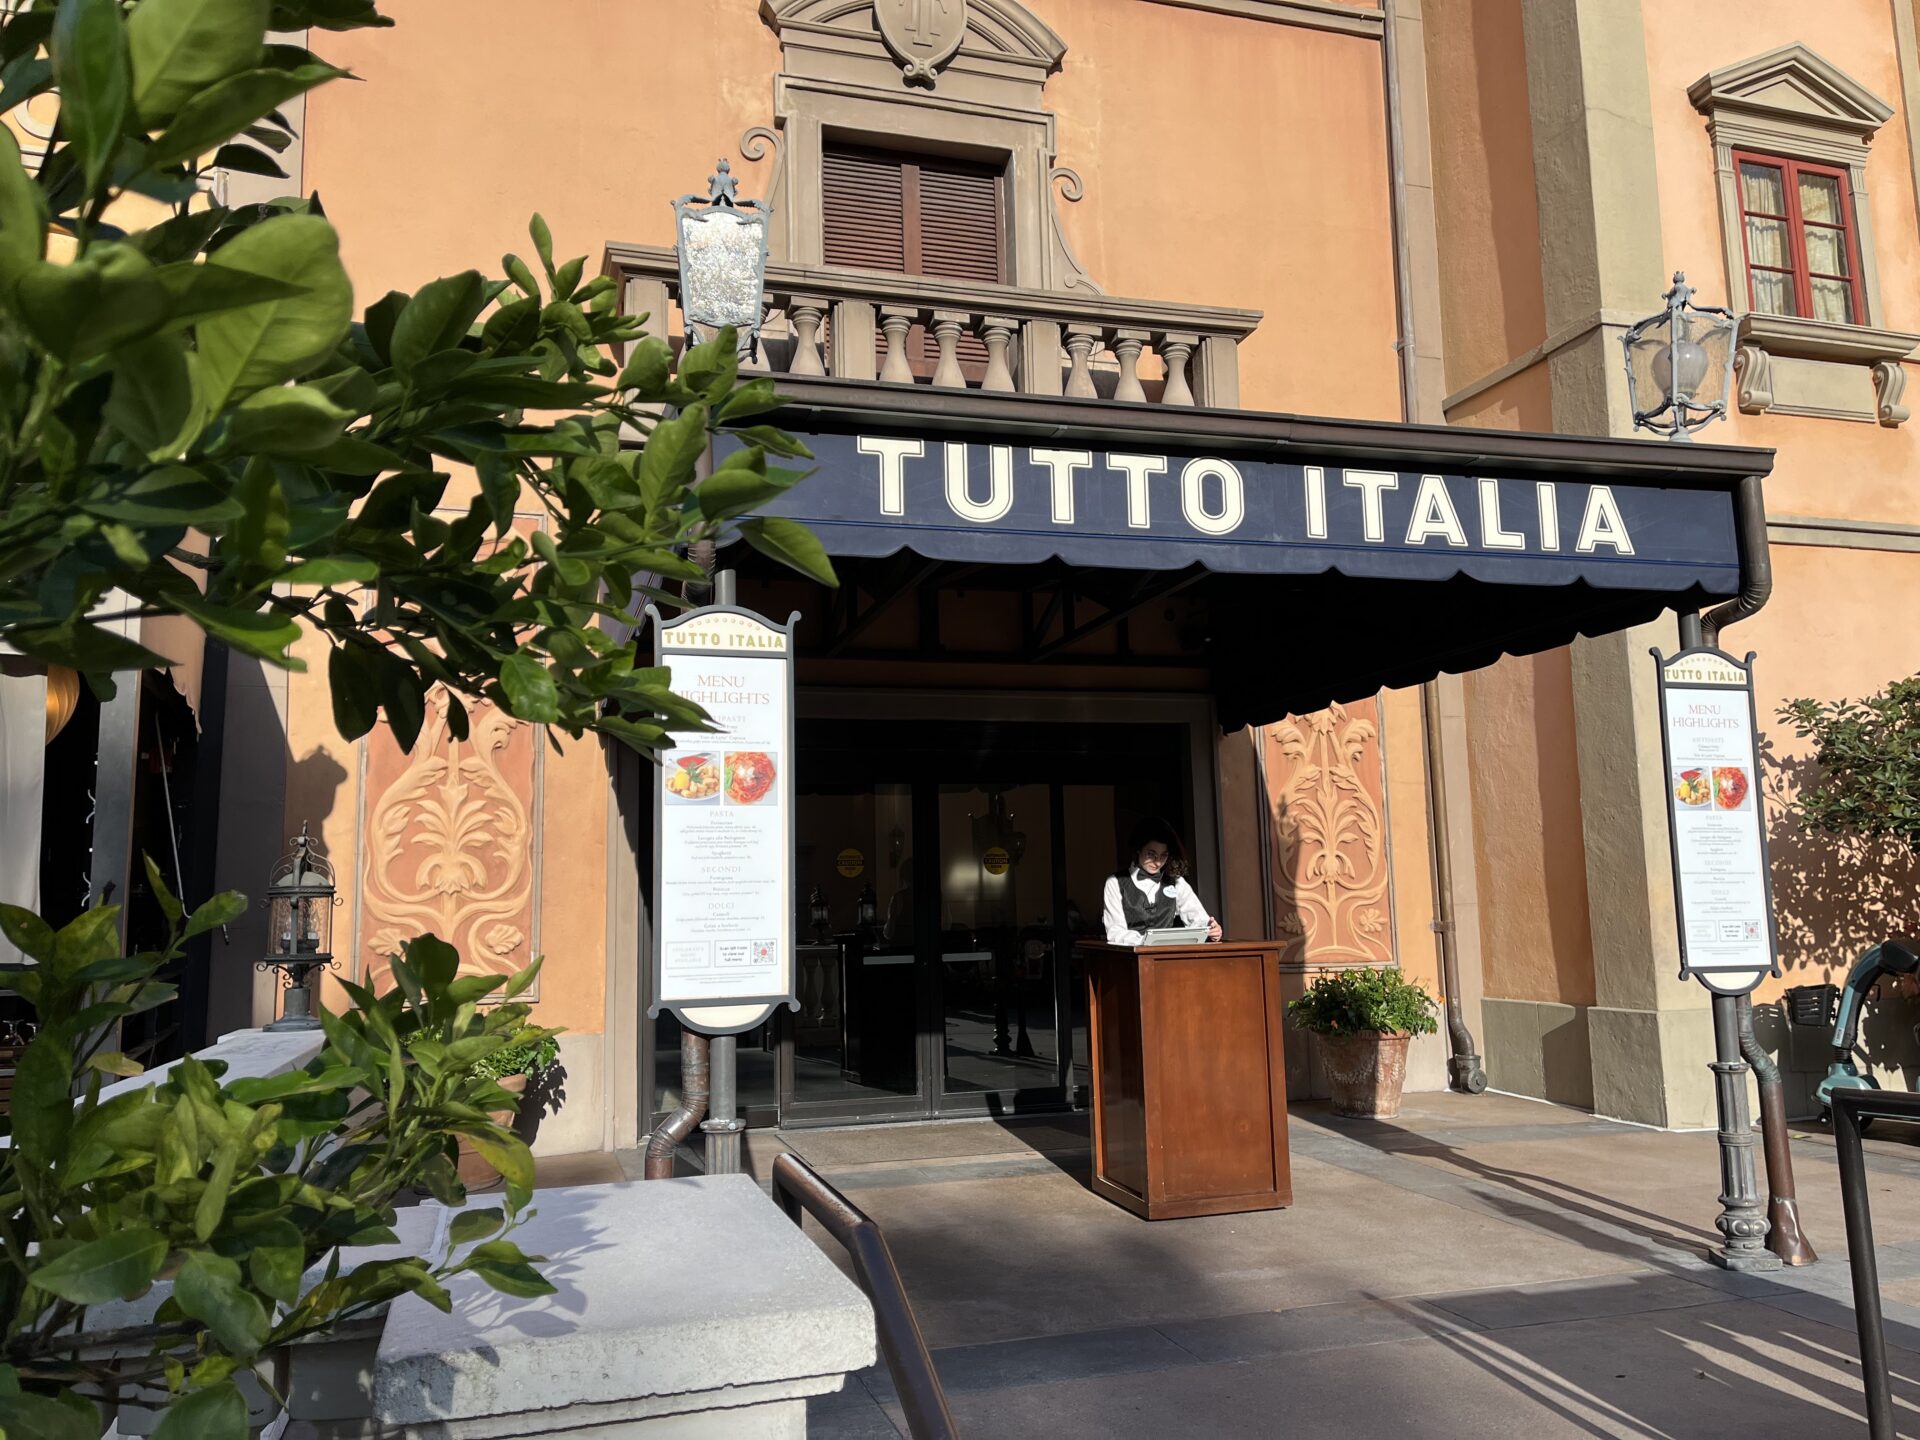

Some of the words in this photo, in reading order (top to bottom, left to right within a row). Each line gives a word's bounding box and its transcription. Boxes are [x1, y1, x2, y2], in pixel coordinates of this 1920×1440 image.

[855, 434, 1246, 537] TUTTO
[1302, 464, 1637, 557] ITALIA
[664, 631, 721, 646] TUTTO
[729, 634, 784, 649] ITALIA
[697, 674, 745, 688] MENU
[1665, 668, 1703, 680] TUTTO
[1707, 670, 1745, 682] ITALIA
[1688, 703, 1722, 715] MENU
[1672, 716, 1740, 729] HIGHLIGHTS
